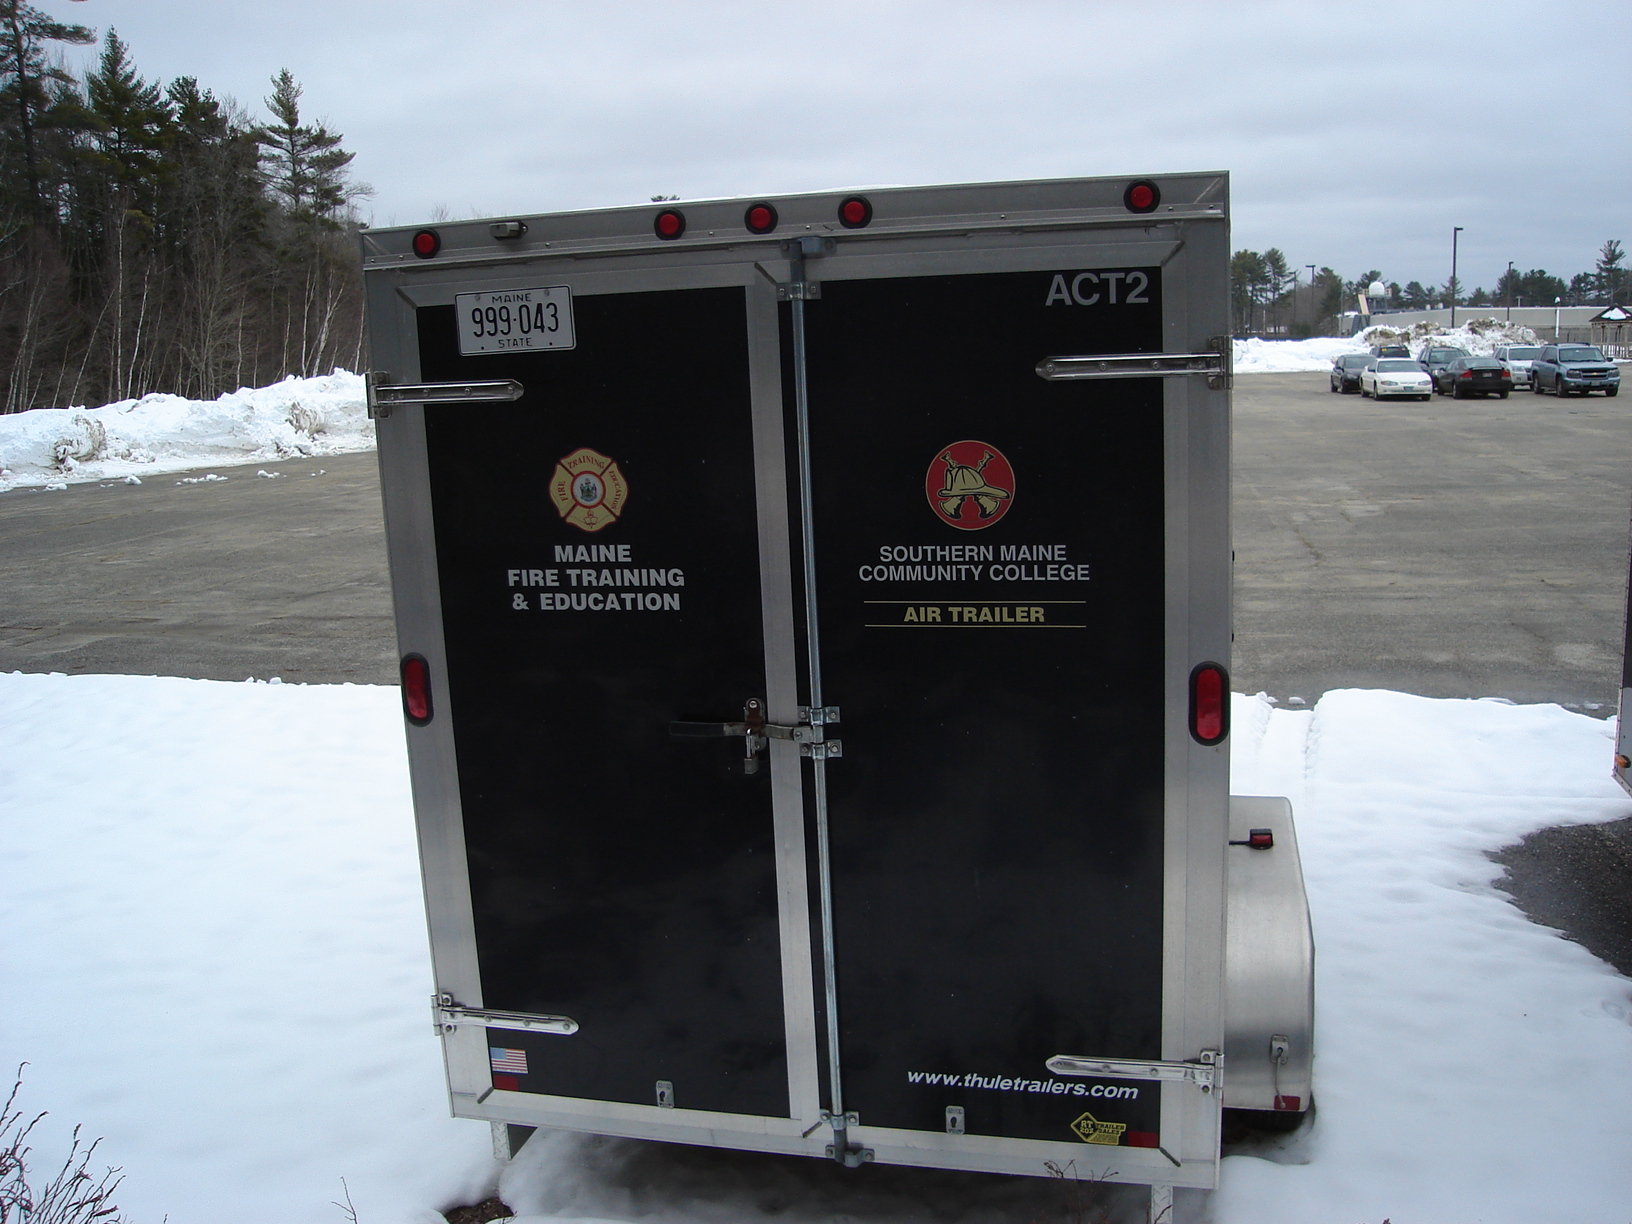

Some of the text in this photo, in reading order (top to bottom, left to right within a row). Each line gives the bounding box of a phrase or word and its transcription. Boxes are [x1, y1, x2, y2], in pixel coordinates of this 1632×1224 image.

[1045, 271, 1149, 307] ACT2
[491, 293, 533, 304] MAINE
[498, 337, 533, 349] STATE
[567, 455, 605, 469] TRAINING
[557, 480, 569, 502] FIRE
[608, 470, 622, 510] EDUCATION
[554, 544, 632, 563] MAINE
[879, 545, 1067, 562] SOUTHERN MAINE
[507, 568, 685, 587] FIRE TRAINING
[858, 564, 1090, 582] COMMUNITY COLLEGE
[512, 593, 681, 611] & EDUCATION
[904, 607, 1045, 622] AIR TRAILER
[907, 1070, 1139, 1100] www.thuletrailers.com
